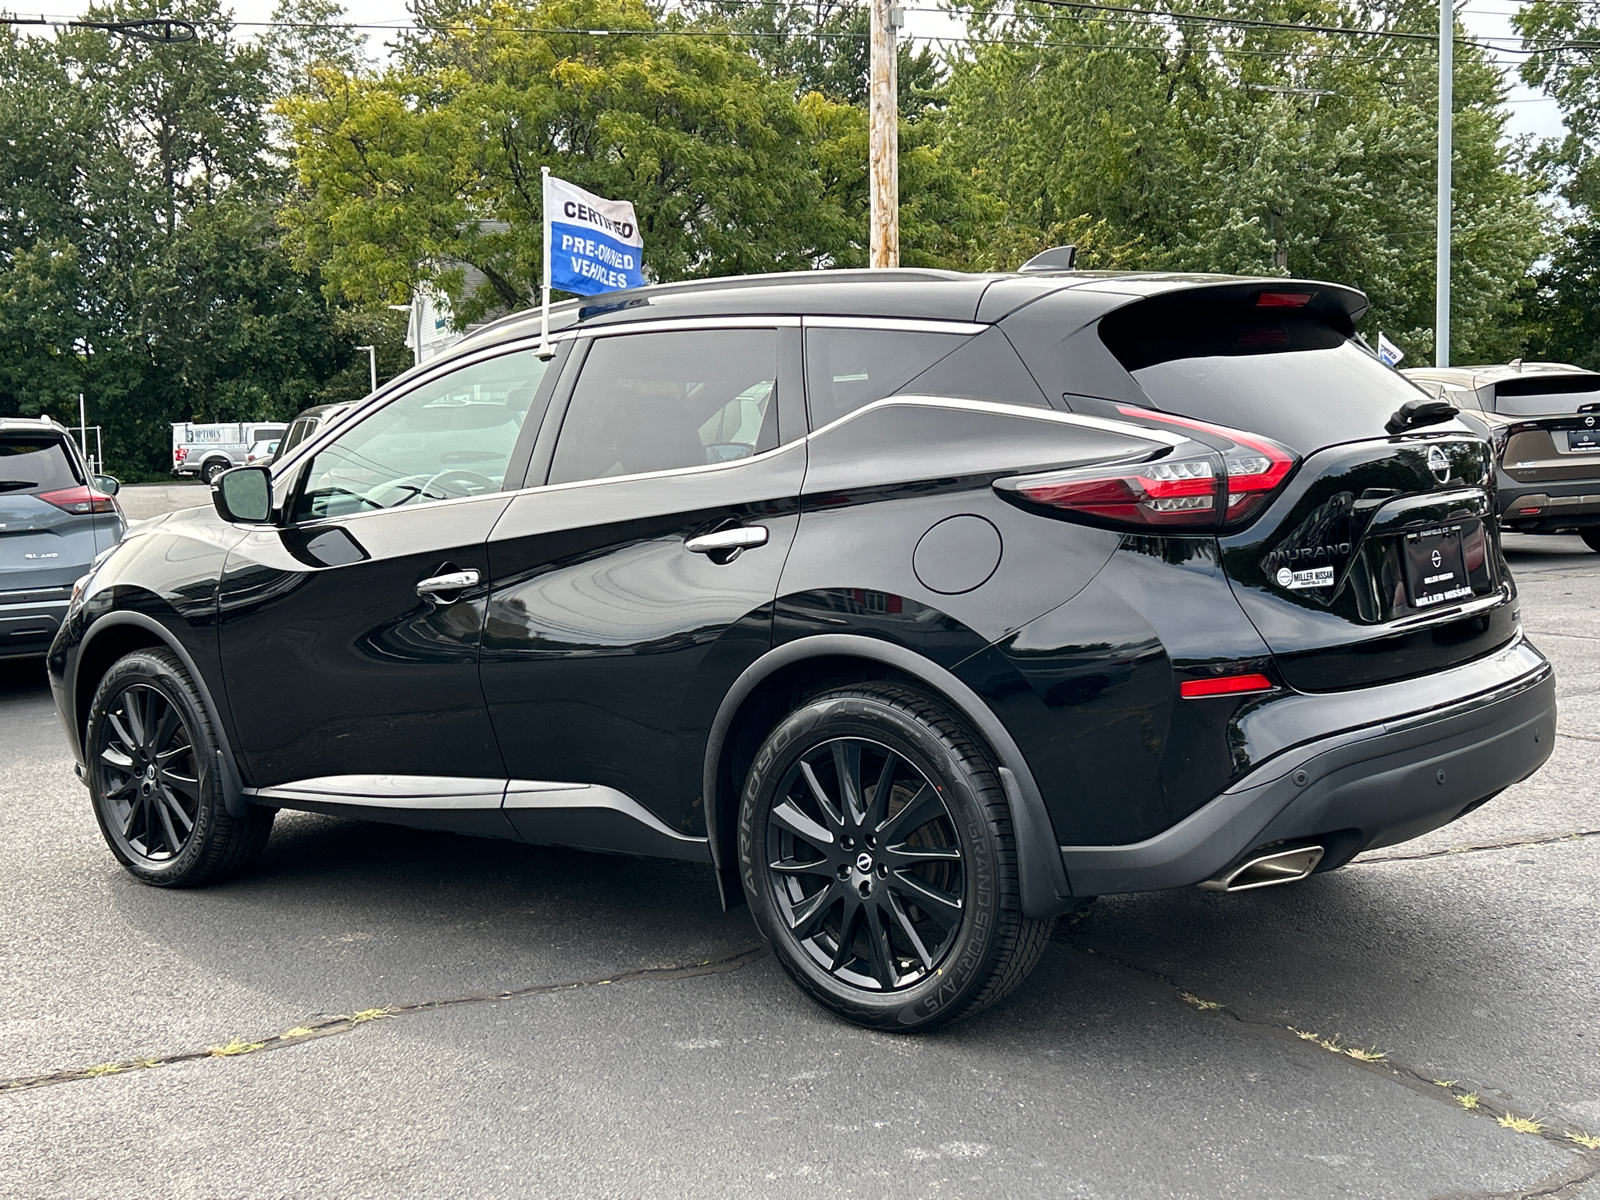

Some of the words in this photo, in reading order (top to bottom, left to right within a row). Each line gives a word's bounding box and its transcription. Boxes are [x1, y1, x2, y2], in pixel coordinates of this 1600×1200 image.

[563, 201, 634, 238] CERTIFIED
[561, 233, 634, 270] PRE-OWNED
[570, 255, 628, 289] VEHICLES
[1269, 542, 1350, 561] MURANO
[1293, 572, 1314, 582] MILLER
[1315, 570, 1333, 580] NISSAN
[1415, 593, 1444, 607] MILLER
[1444, 586, 1472, 600] NISSAN
[741, 726, 791, 897] ARROYO
[190, 805, 209, 856] GRAND
[967, 823, 991, 907] GRAND
[955, 911, 990, 983] SPORT
[923, 980, 959, 1013] A/S
